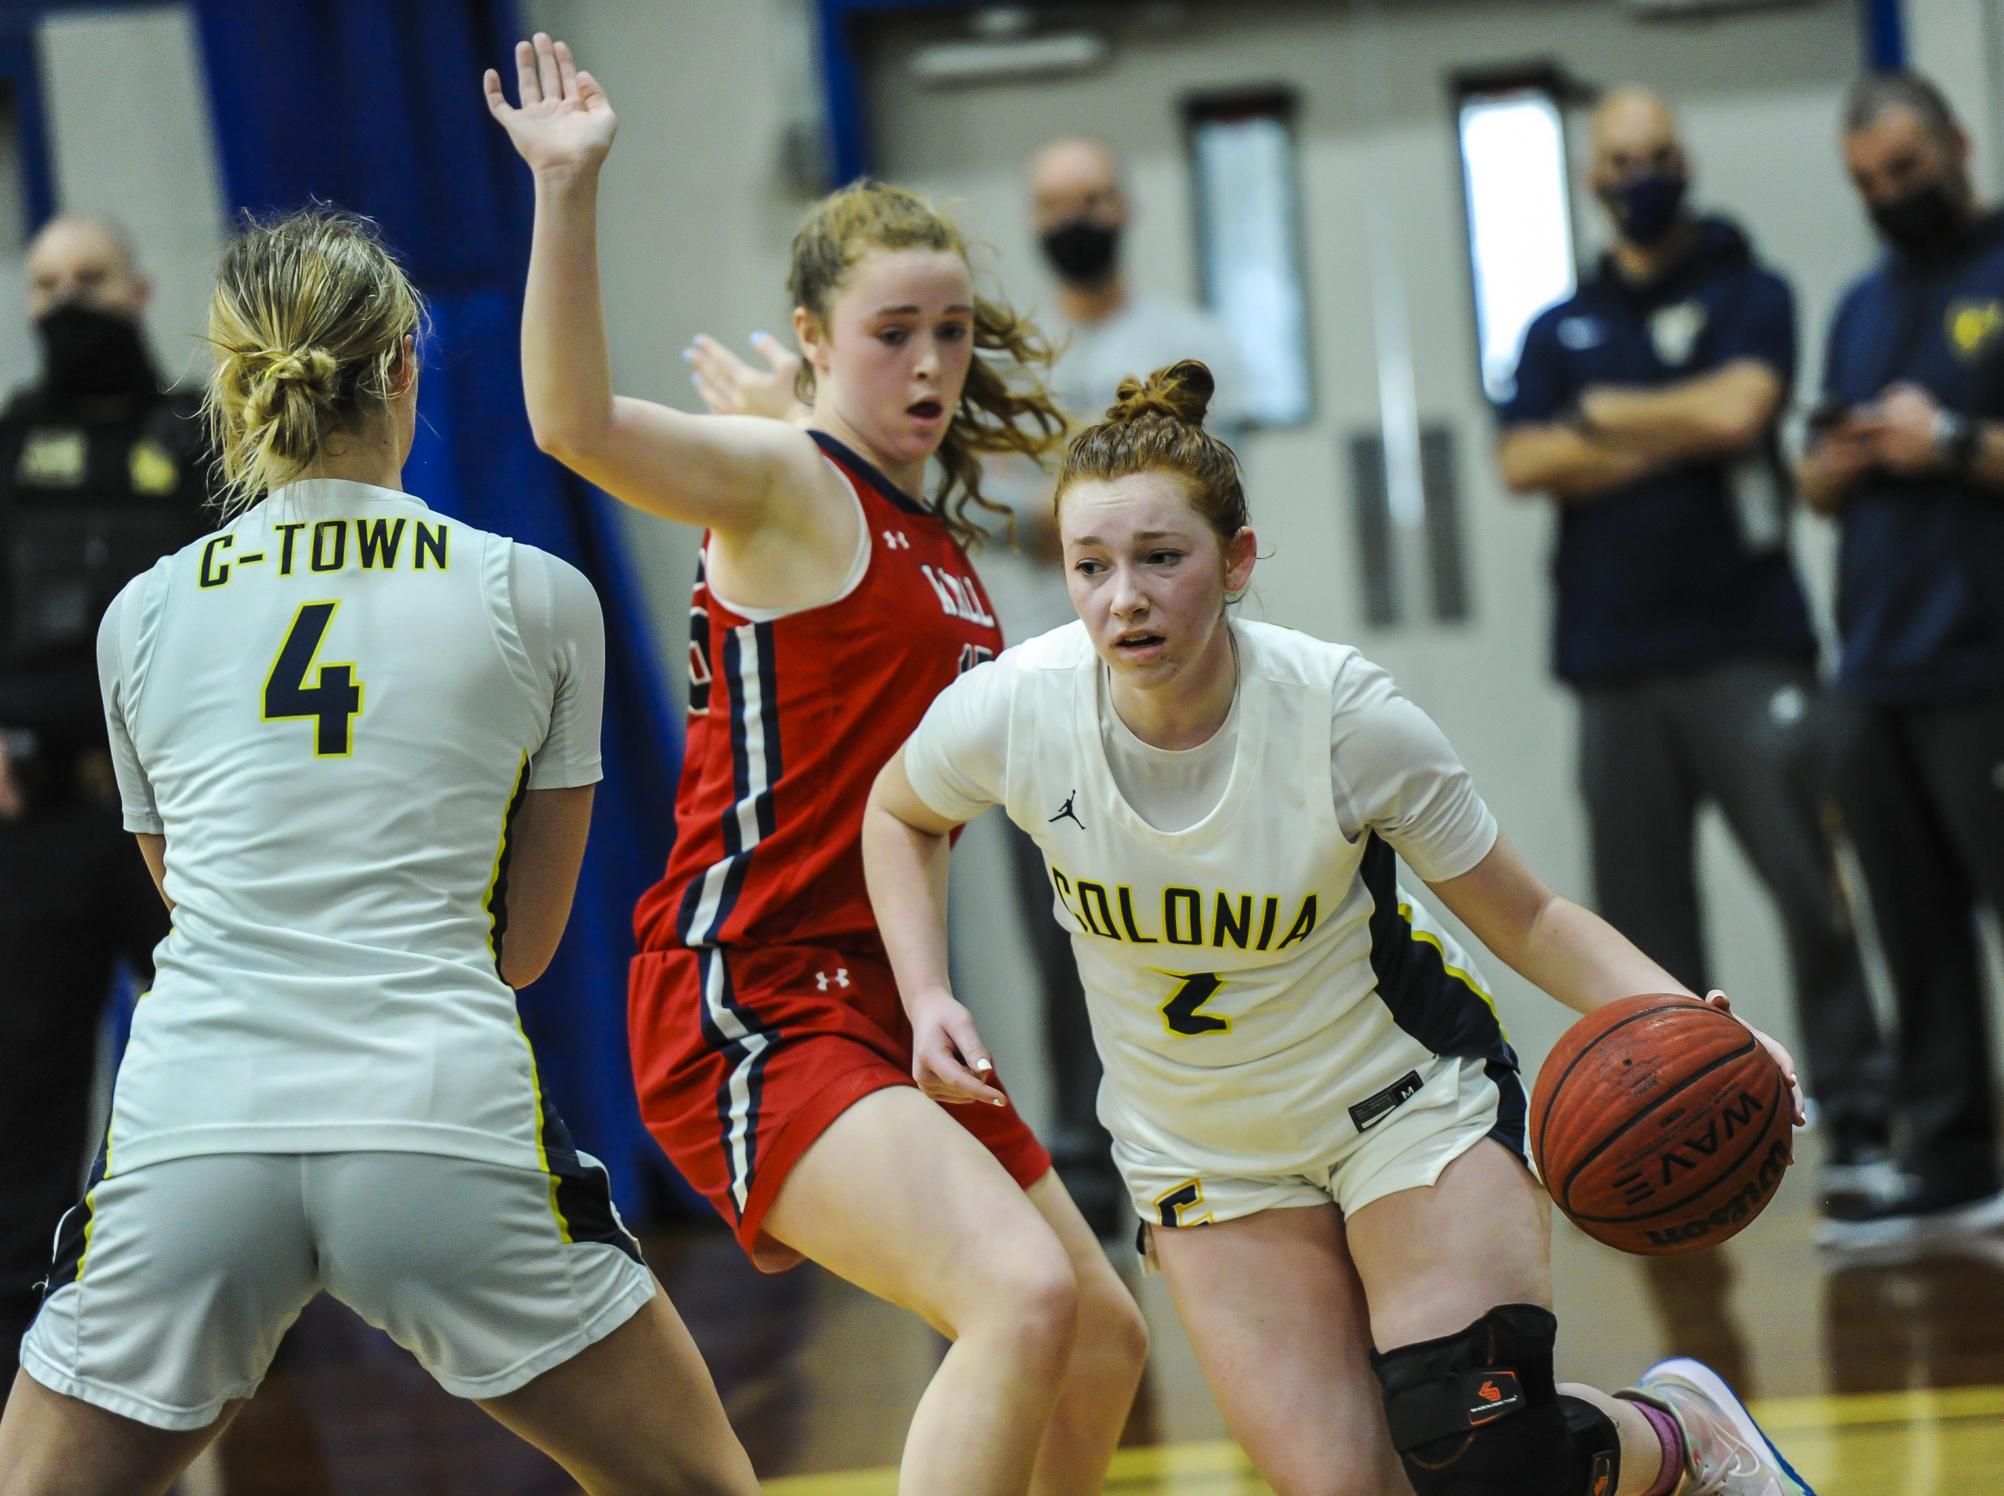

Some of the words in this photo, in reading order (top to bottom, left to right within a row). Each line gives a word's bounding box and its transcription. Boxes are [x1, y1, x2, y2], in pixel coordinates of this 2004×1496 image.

[199, 517, 449, 589] C-TOWN
[261, 600, 364, 758] 4
[1051, 866, 1319, 952] COLONIA
[1146, 966, 1232, 1037] 2
[1613, 1092, 1763, 1206] WAVE
[1644, 1139, 1791, 1246] Wilson
